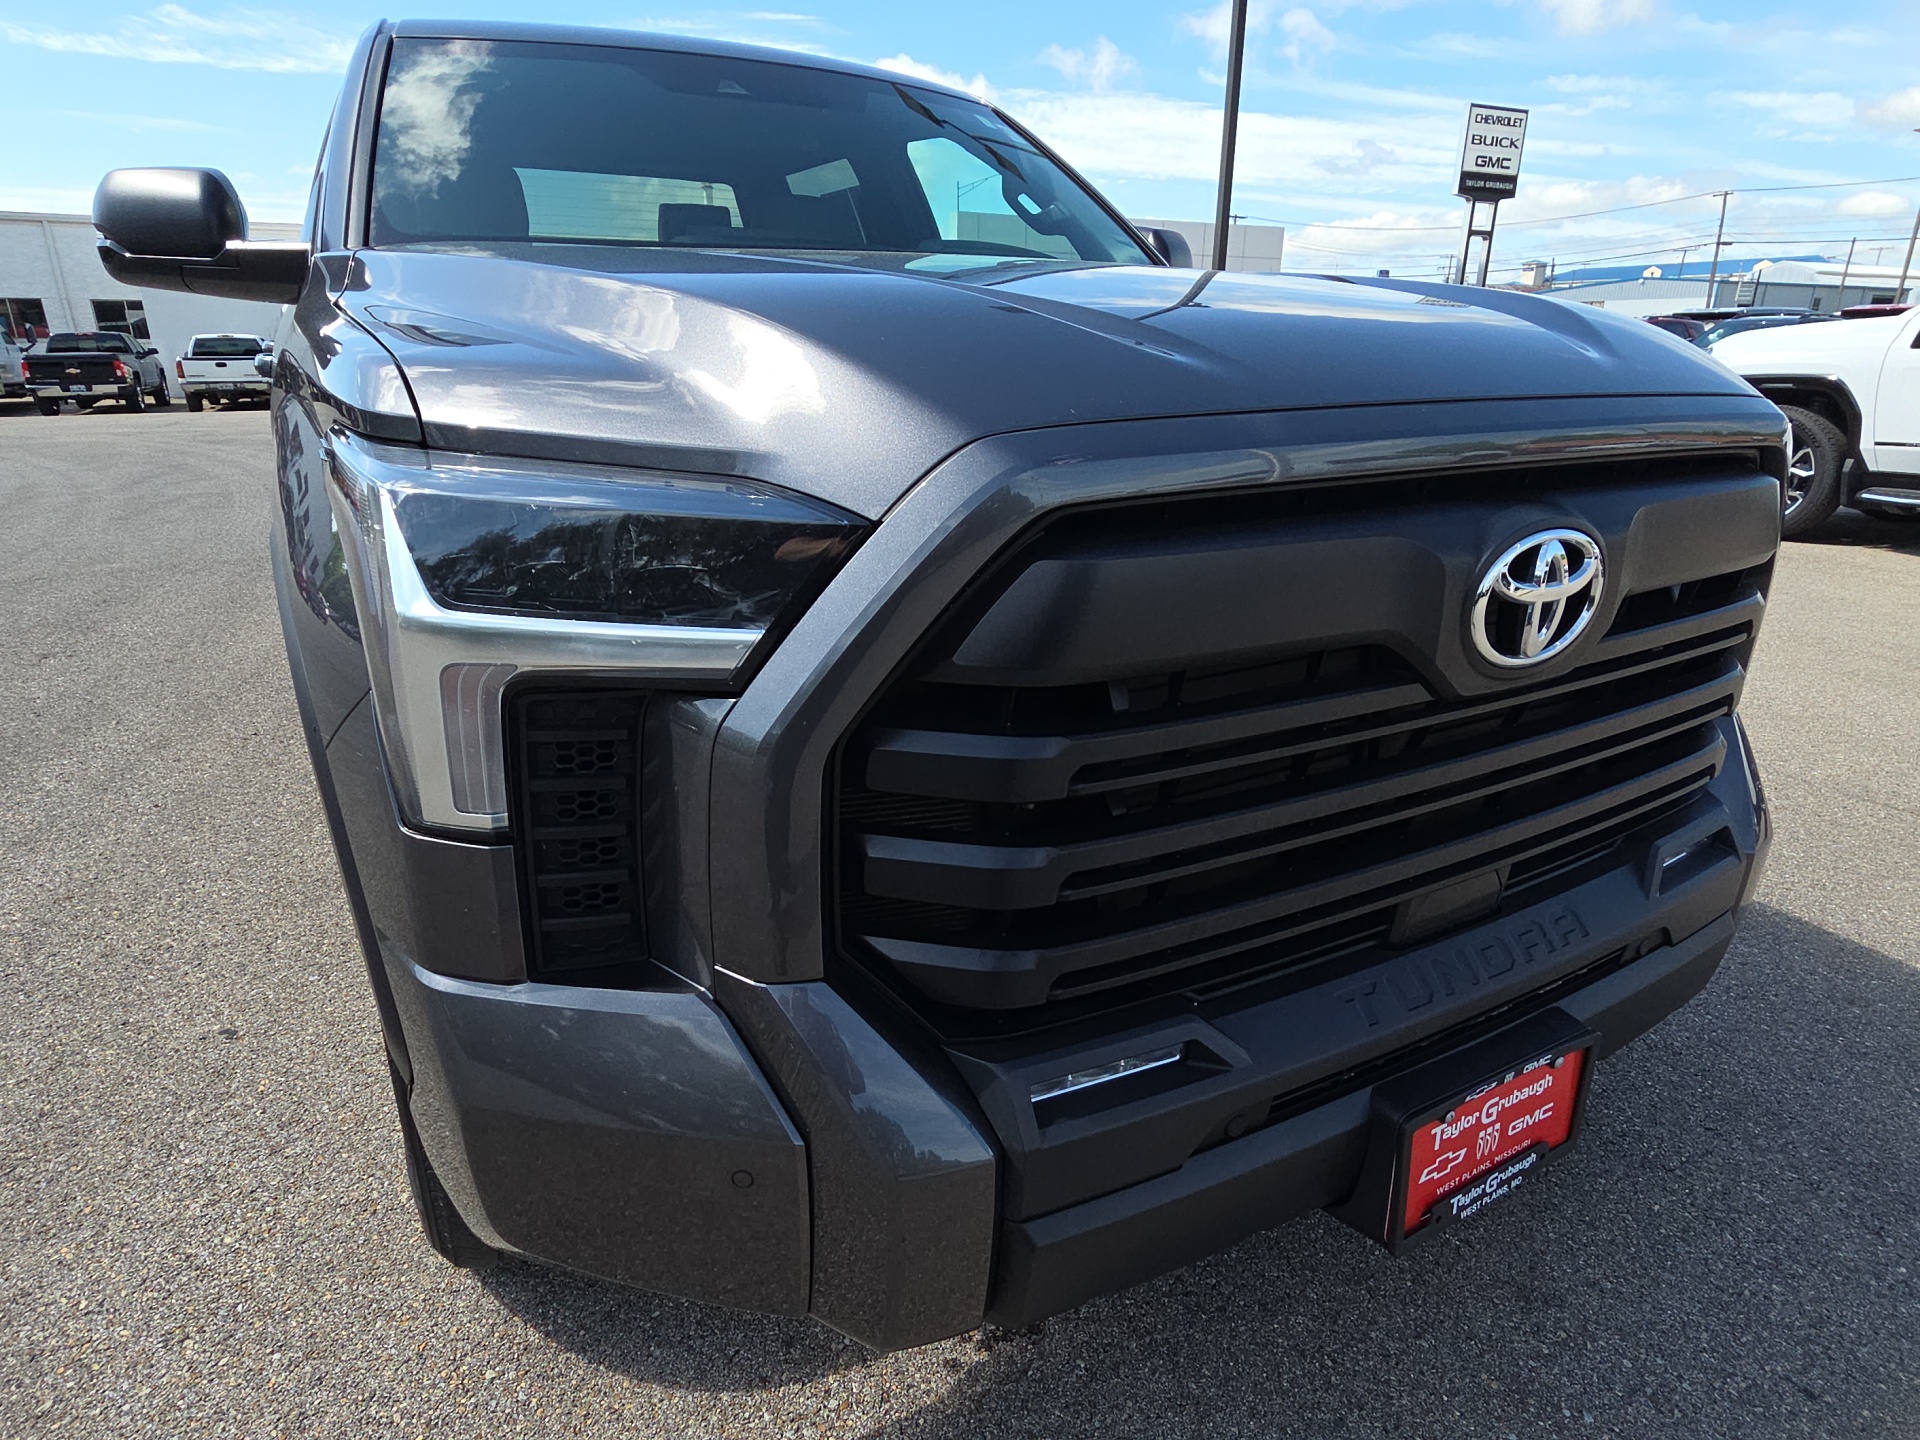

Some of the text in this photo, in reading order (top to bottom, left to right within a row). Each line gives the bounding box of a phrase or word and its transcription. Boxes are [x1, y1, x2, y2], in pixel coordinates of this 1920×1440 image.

[1475, 113, 1524, 128] CHEVROLET
[1471, 134, 1520, 149] BUICK
[1475, 155, 1512, 169] GMC
[1466, 180, 1514, 190] TAYLOR GRUBAUGH
[1334, 905, 1591, 1027] TUNDRA
[1522, 1054, 1553, 1074] GMC
[1431, 1073, 1553, 1151] Taylor Grubaugh
[1507, 1102, 1554, 1136] GMC
[1436, 1178, 1461, 1196] WEST
[1494, 1138, 1532, 1163] MISSOURI
[1450, 1152, 1537, 1216] Taylor Grubaugh
[1460, 1201, 1482, 1220] WEST
[1510, 1176, 1523, 1189] MO
